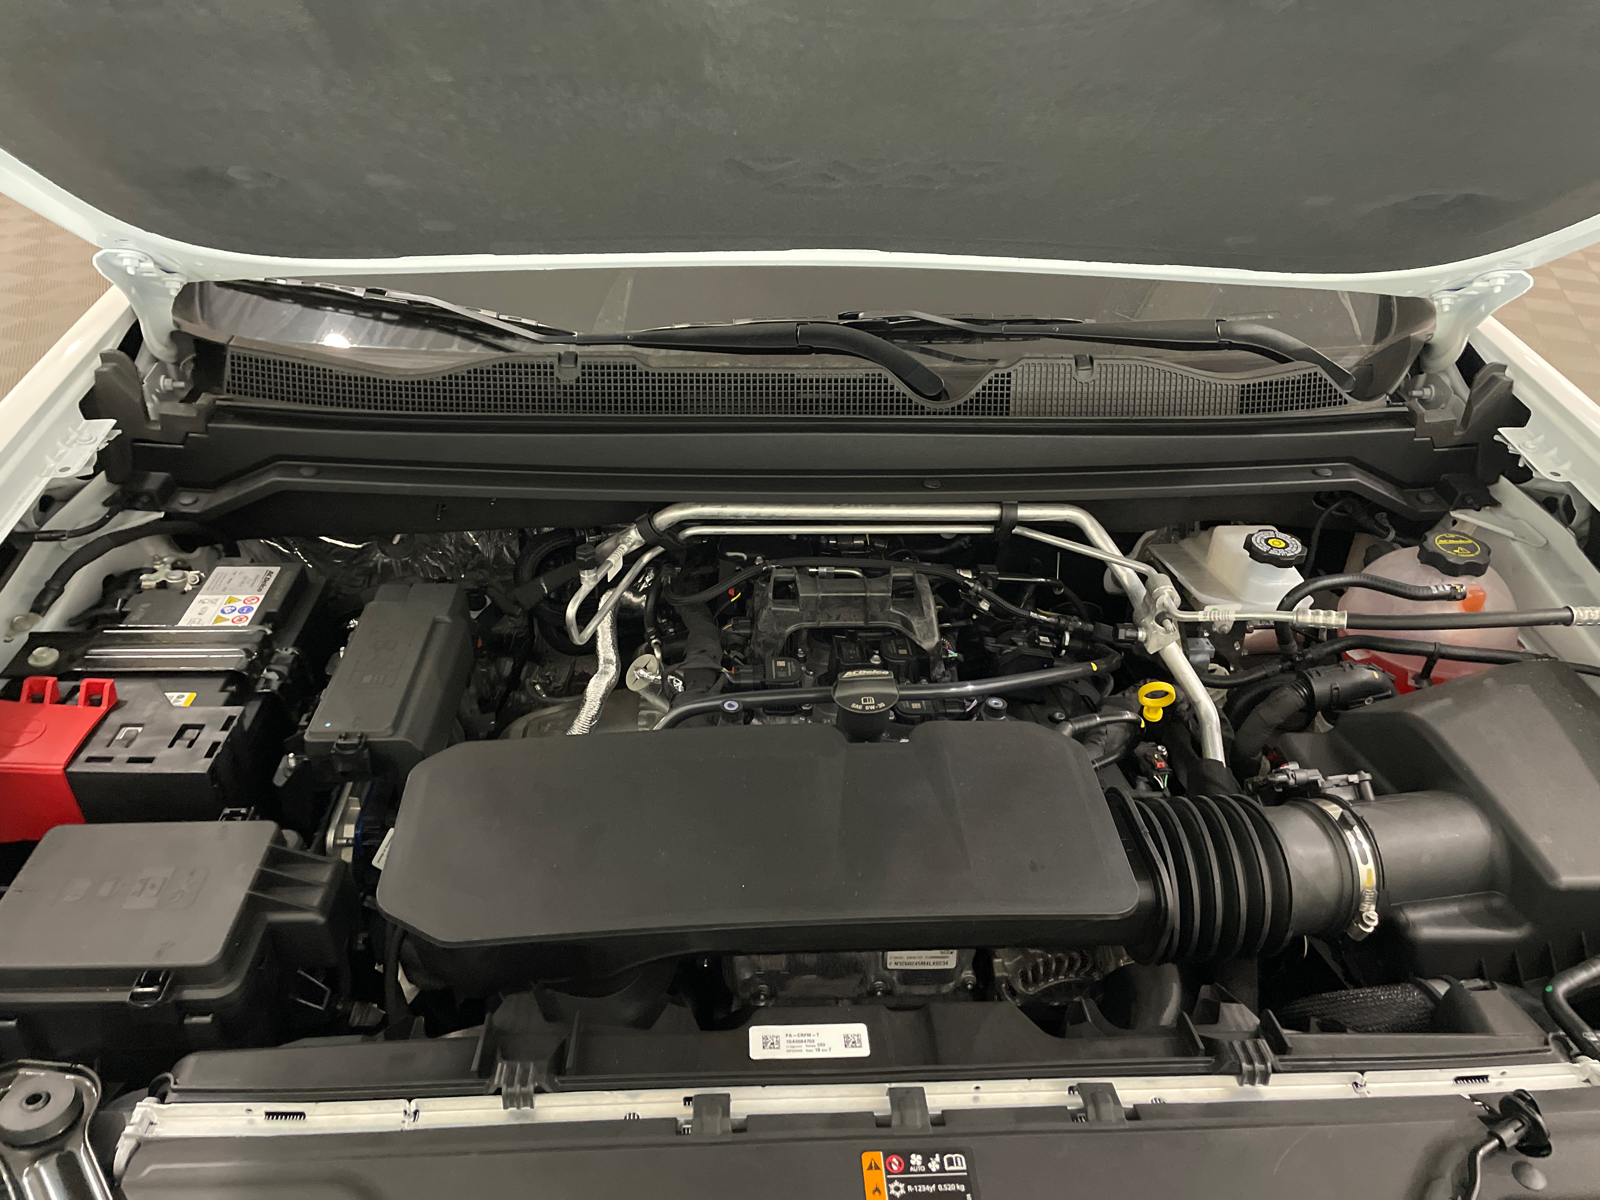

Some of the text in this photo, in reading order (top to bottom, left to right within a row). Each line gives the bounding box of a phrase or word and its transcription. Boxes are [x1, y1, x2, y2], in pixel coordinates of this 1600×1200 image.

[842, 670, 889, 678] ACDelco
[907, 1183, 966, 1193] R-1234yf 0.520 kg
